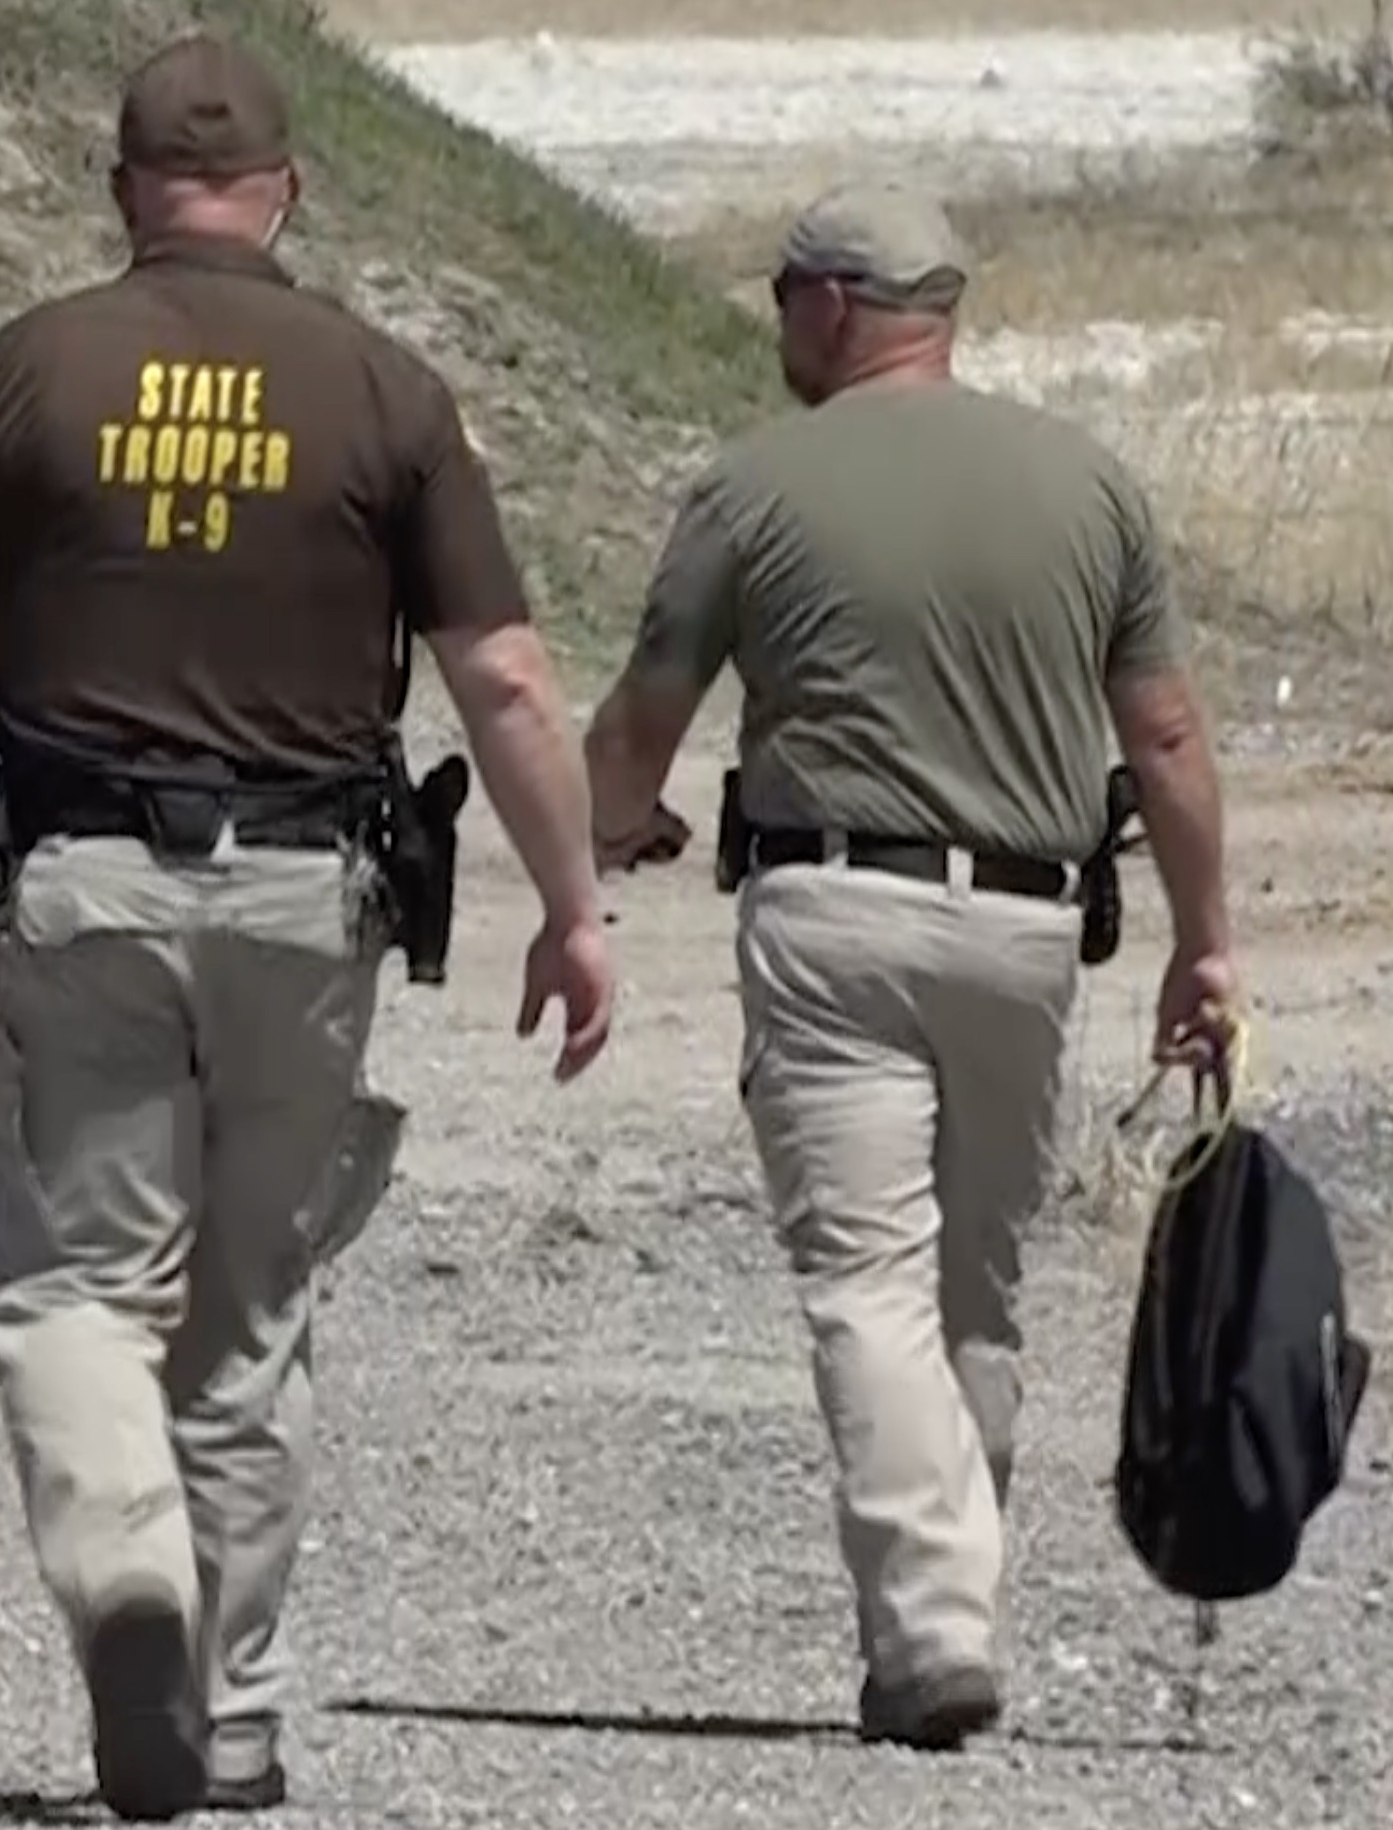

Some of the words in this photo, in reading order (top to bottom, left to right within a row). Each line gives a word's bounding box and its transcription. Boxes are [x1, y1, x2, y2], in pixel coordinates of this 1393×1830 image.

[138, 361, 263, 425] STATE
[99, 423, 290, 491] TROOPER
[146, 490, 230, 552] K-9
